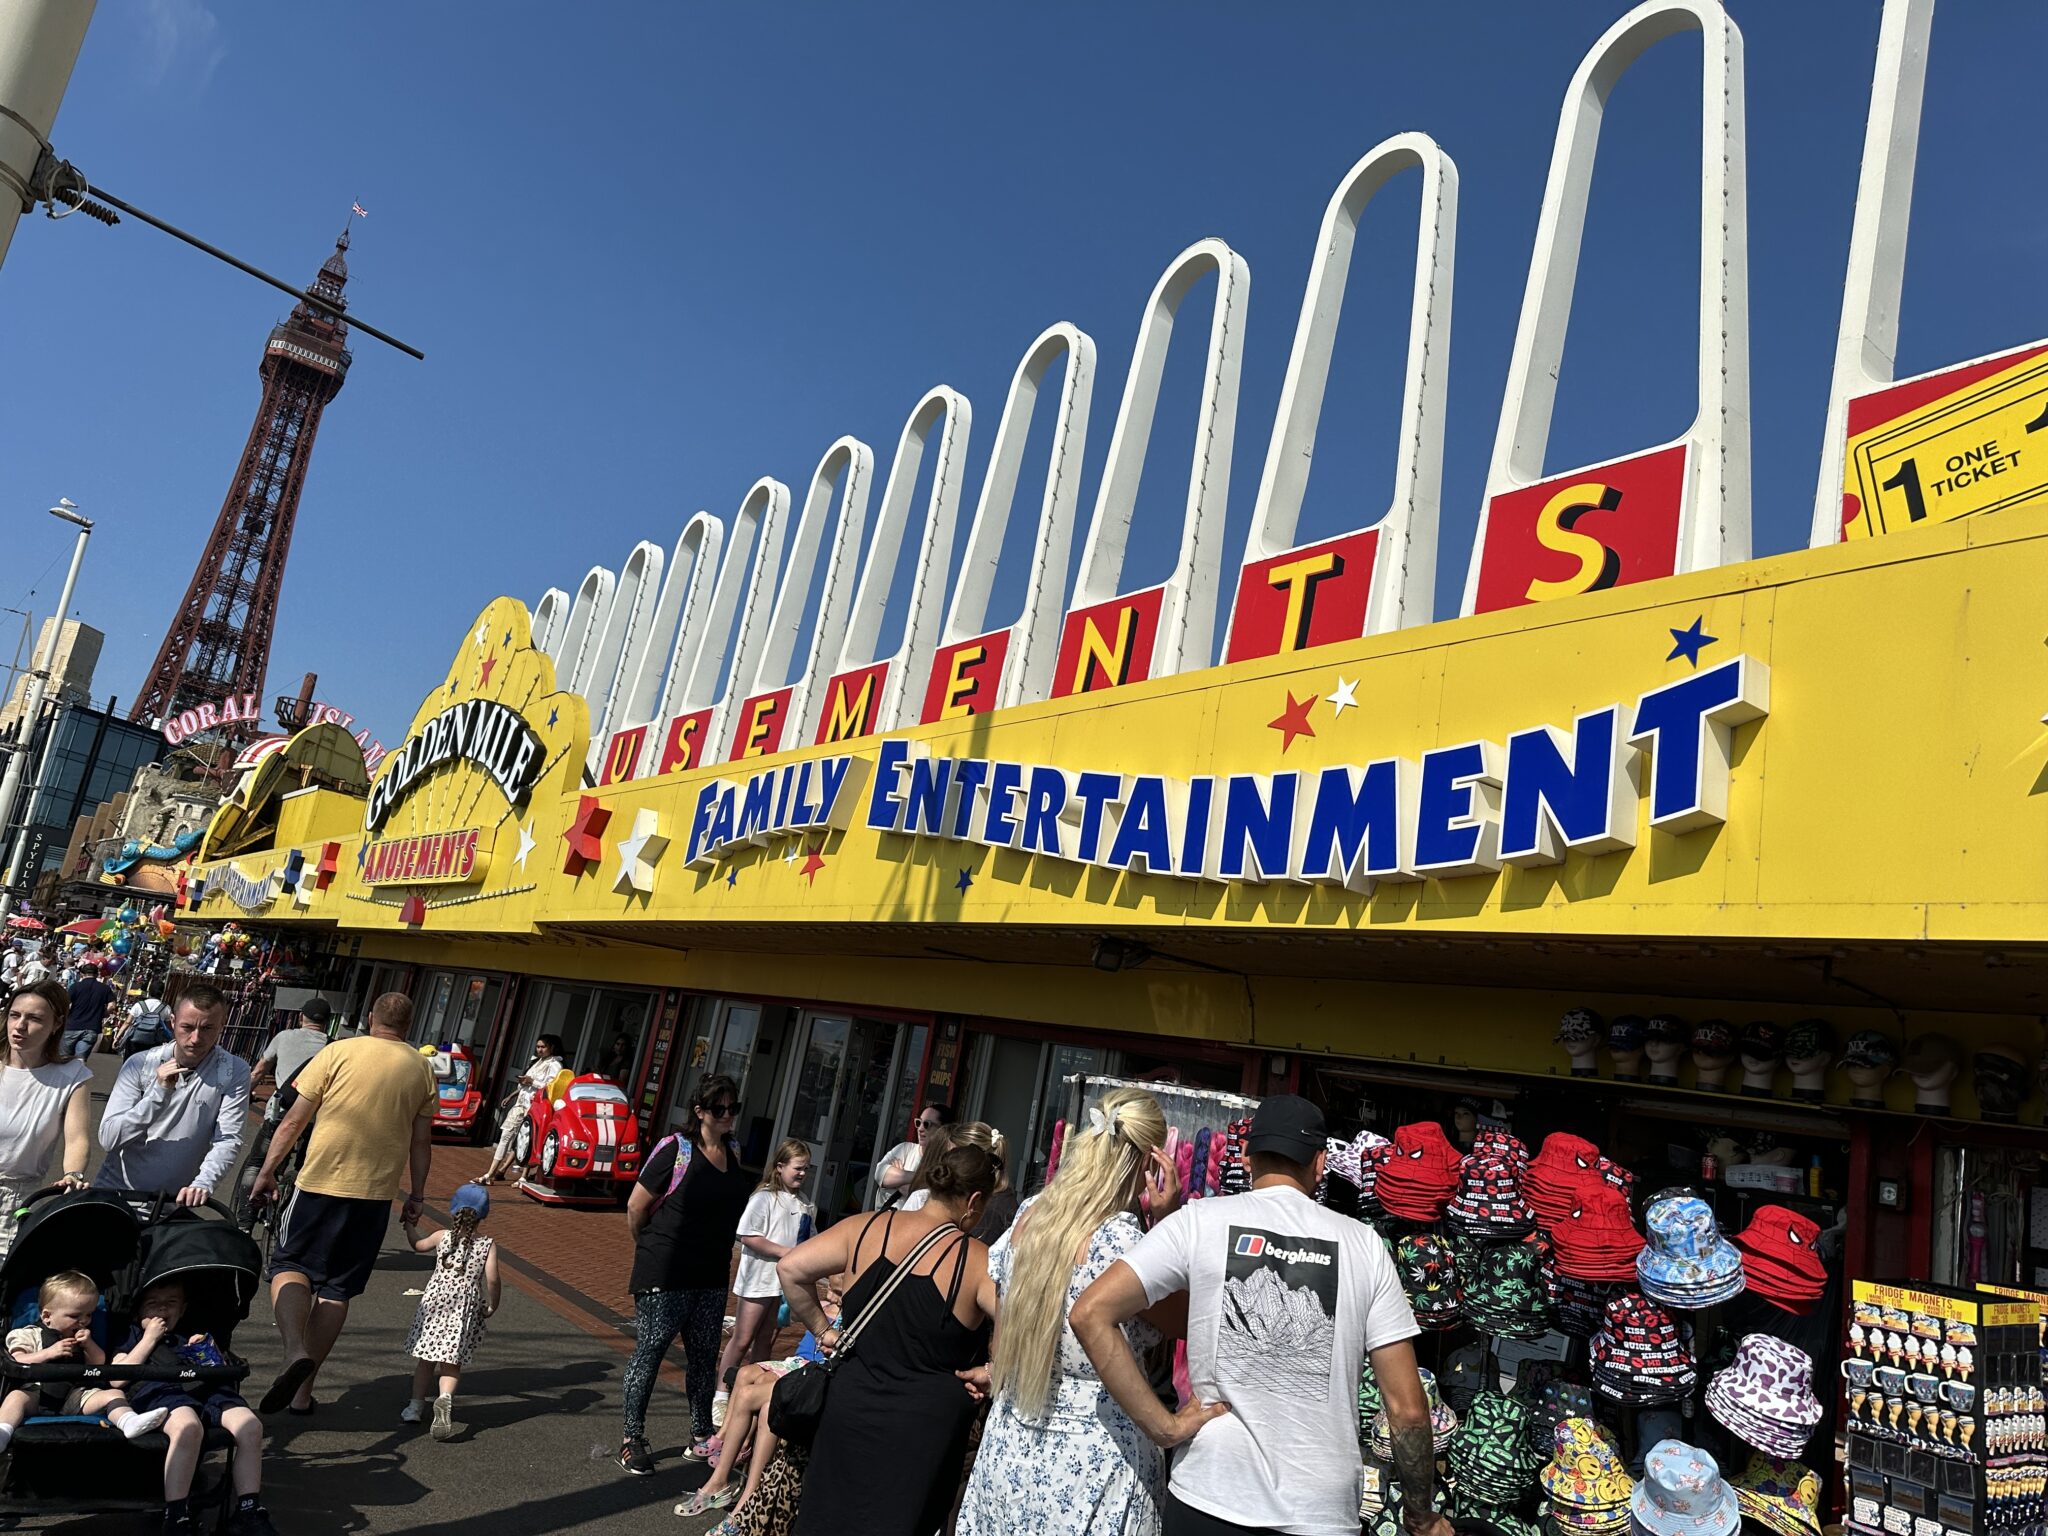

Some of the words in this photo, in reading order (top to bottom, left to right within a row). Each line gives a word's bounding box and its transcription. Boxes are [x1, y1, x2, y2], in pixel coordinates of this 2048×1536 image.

[1945, 439, 2000, 473] ONE
[1930, 450, 2022, 497] TICKET
[1882, 458, 1927, 523] 1
[163, 693, 258, 745] CORAL
[307, 701, 388, 782] ISLAN
[366, 699, 478, 831] GOLDEN
[467, 700, 537, 804] MILE
[684, 755, 857, 871] FAMILY
[866, 654, 1750, 893] ENTERTAINMENT
[362, 828, 480, 884] AMUSEMENTS
[14, 833, 43, 907] SPYGLAS
[1611, 1025, 1629, 1037] NY
[1648, 1019, 1667, 1030] NY
[1696, 1029, 1716, 1041] NY
[1467, 1179, 1484, 1187] KISS
[1497, 1179, 1513, 1187] KISS
[1466, 1193, 1489, 1201] QUICK
[1496, 1192, 1516, 1200] QUICK
[1265, 1242, 1332, 1266] berghaus
[1875, 1284, 1904, 1300] FRIDGE
[1909, 1291, 1953, 1310] MAGNETS
[1625, 1326, 1645, 1335] KISS
[1624, 1341, 1652, 1351] QUICK
[1611, 1348, 1630, 1357] KISS
[1641, 1352, 1662, 1360] KISS
[83, 1368, 101, 1377] Joie
[179, 1369, 196, 1378] Joie
[1605, 1361, 1631, 1373] QUICK
[1633, 1375, 1662, 1386] QUICK
[1600, 1384, 1624, 1399] QUICK
